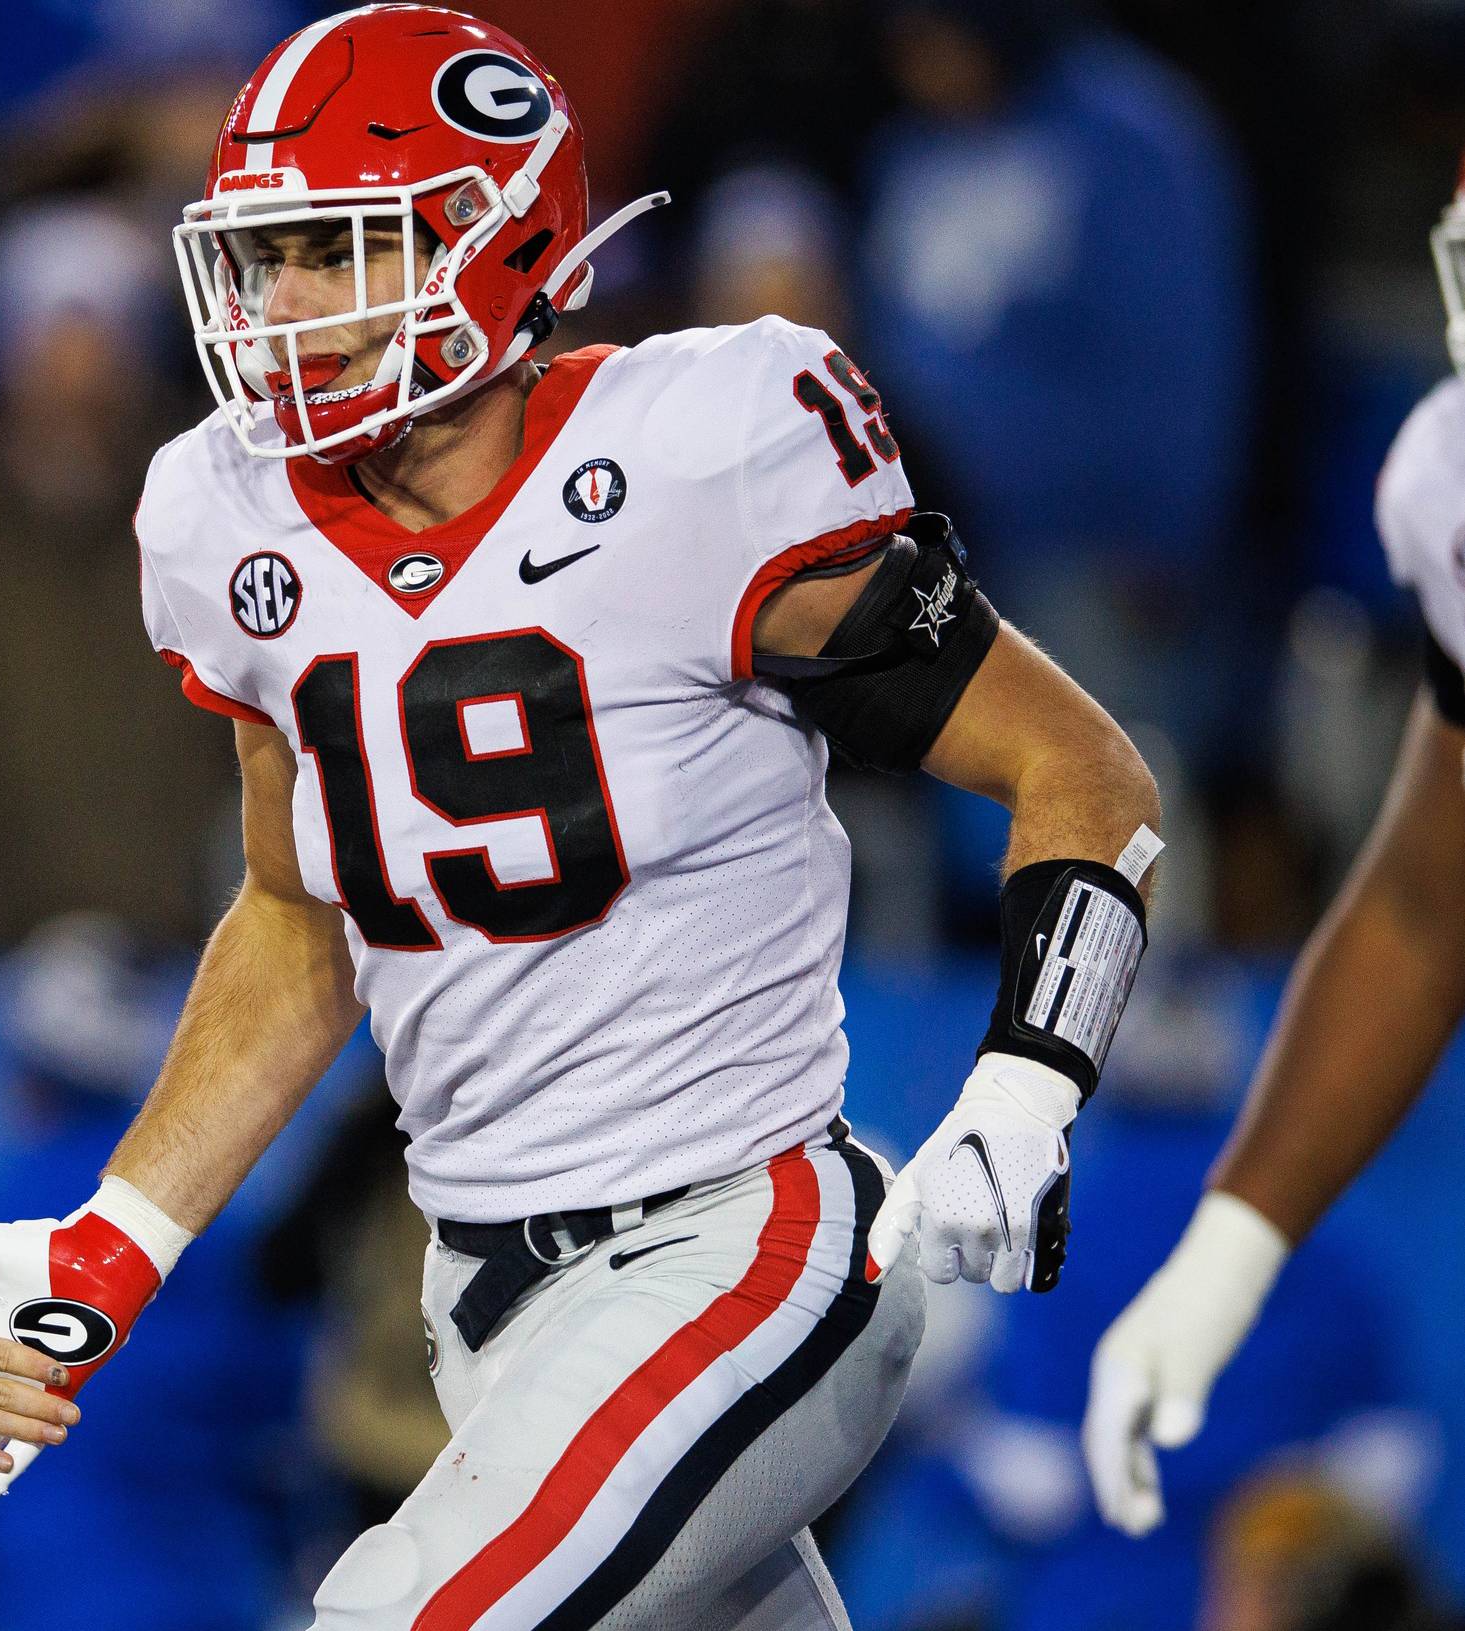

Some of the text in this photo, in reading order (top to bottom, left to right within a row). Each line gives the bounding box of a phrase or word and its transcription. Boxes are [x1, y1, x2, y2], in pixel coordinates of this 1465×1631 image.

[431, 49, 554, 144] G
[219, 173, 285, 192] DAWGS
[585, 460, 611, 469] MEMORY
[234, 557, 295, 633] SEC
[388, 552, 444, 594] G
[926, 563, 957, 623] Douglas
[291, 626, 631, 952] 19
